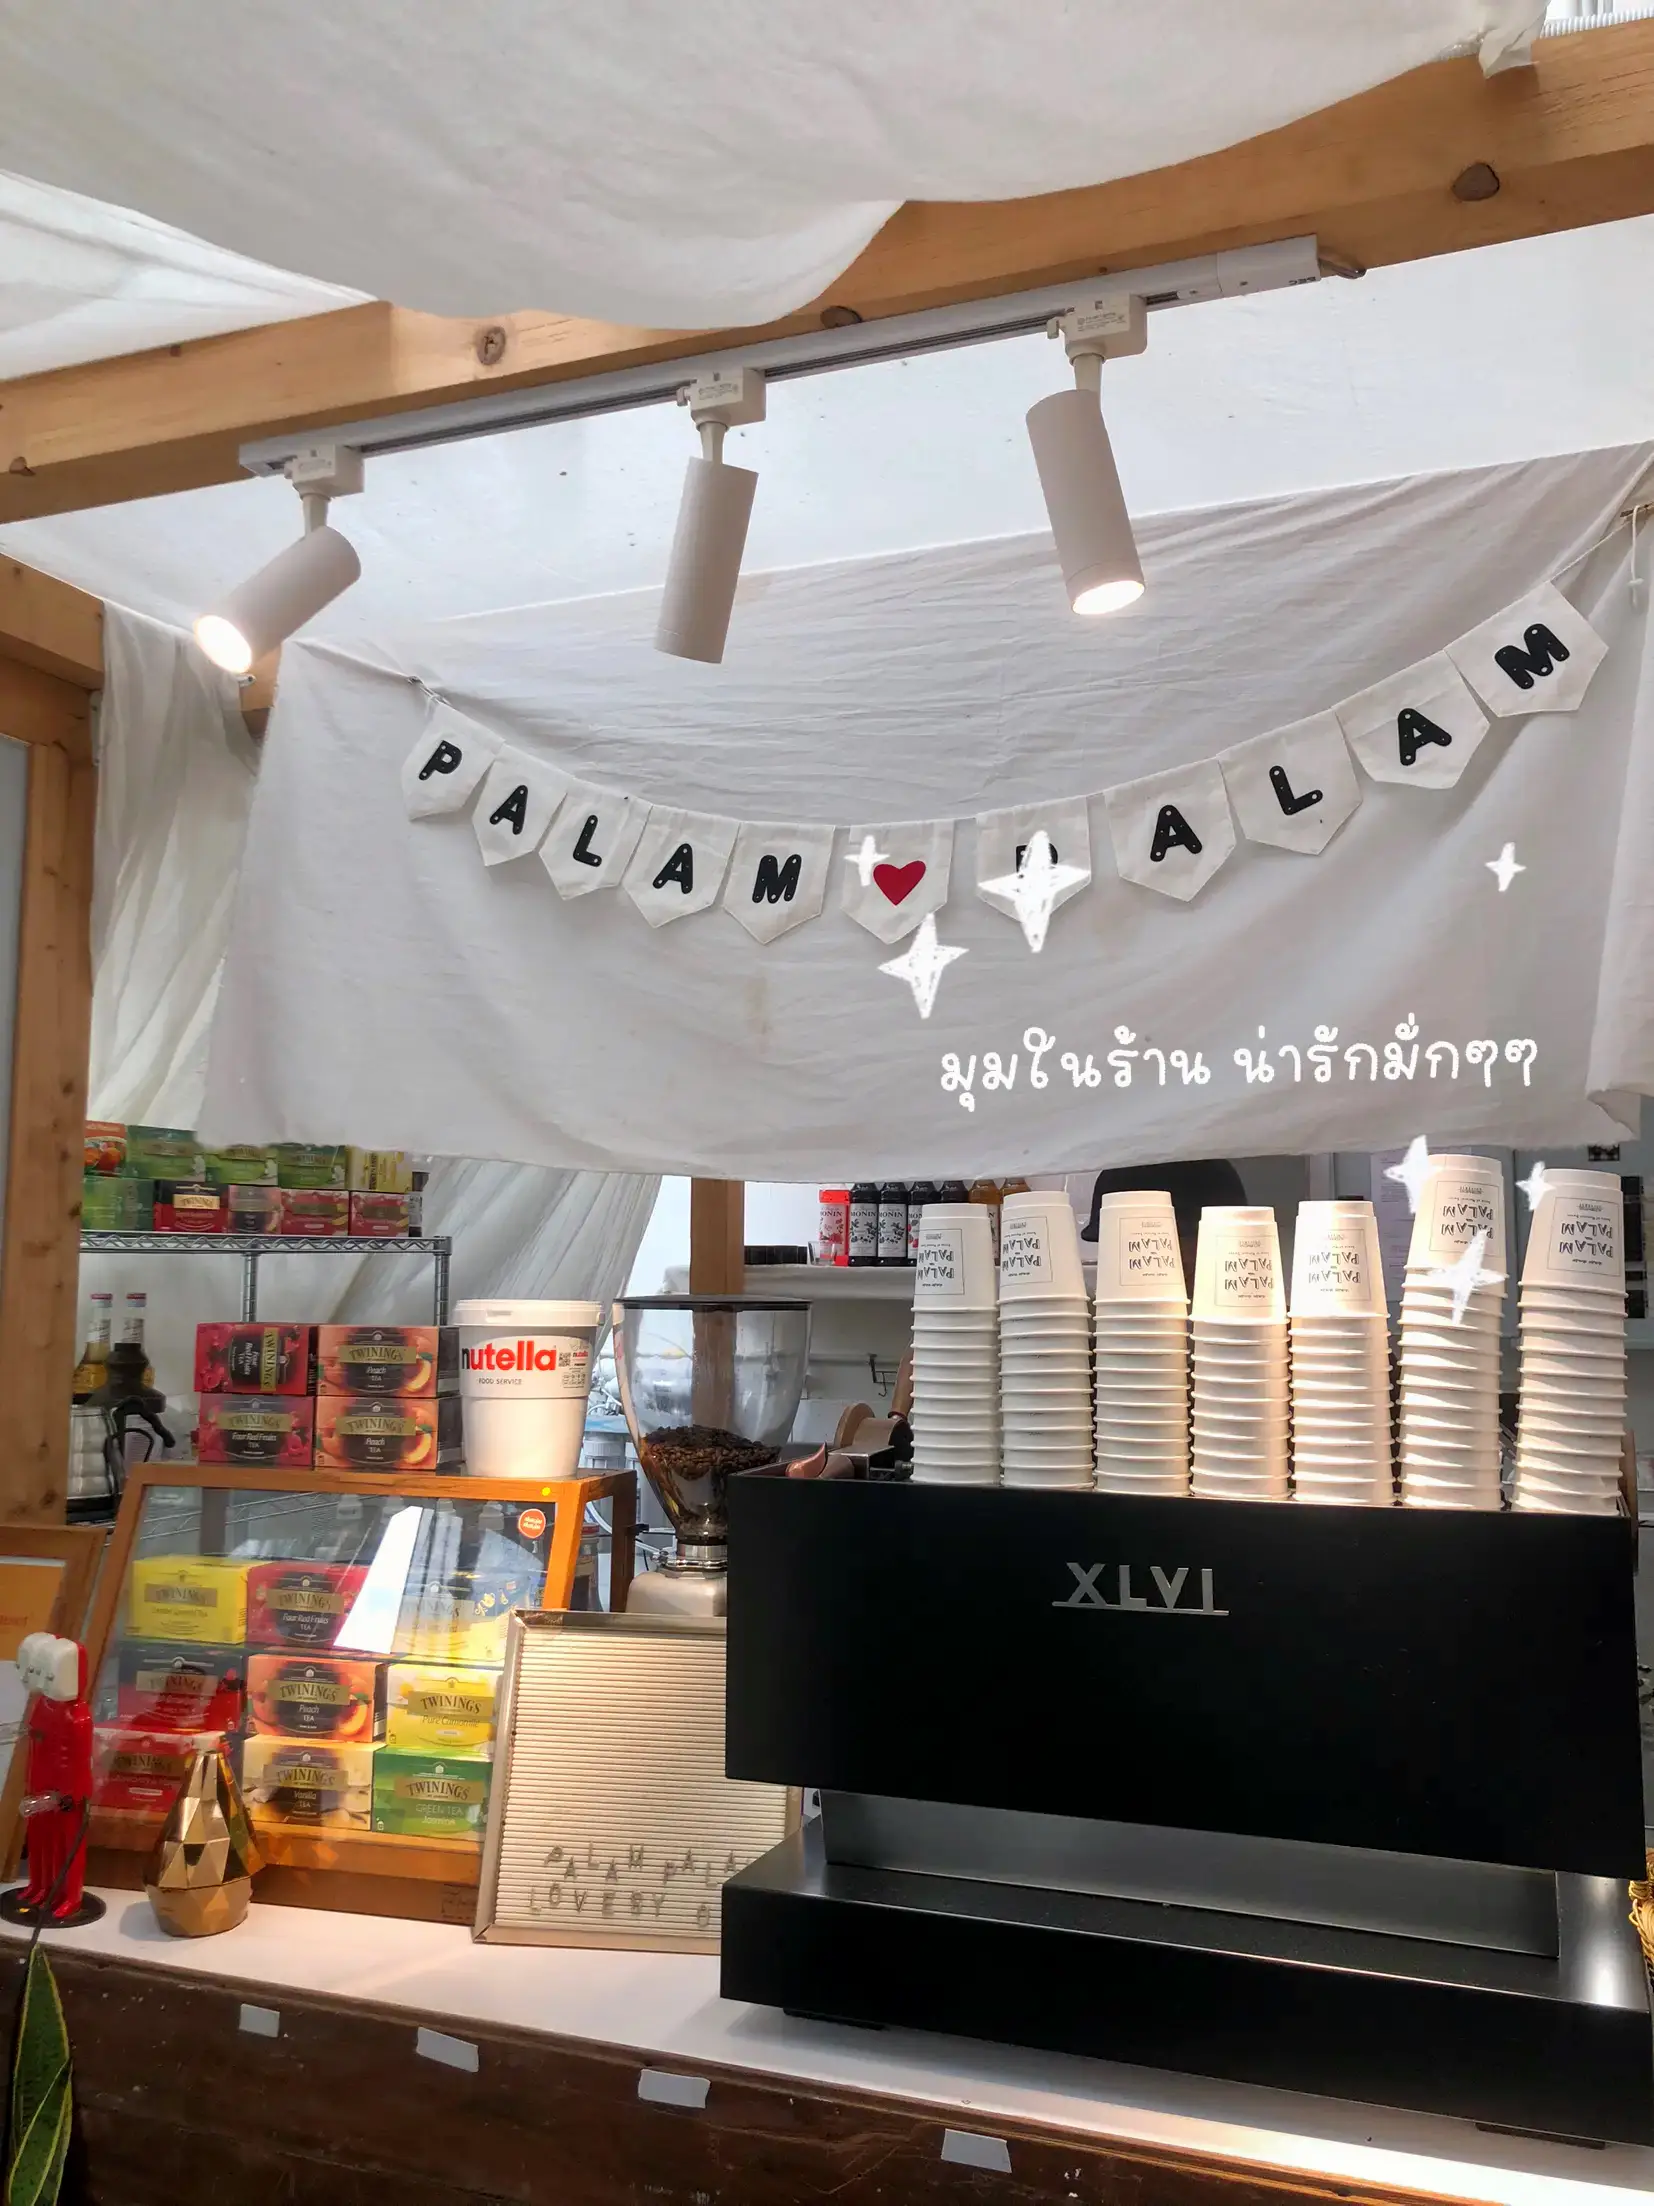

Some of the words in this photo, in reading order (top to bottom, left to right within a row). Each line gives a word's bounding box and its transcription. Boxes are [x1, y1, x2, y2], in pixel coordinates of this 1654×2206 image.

[349, 1346, 404, 1361] TWININGS
[461, 1340, 557, 1371] nutella
[366, 1366, 387, 1375] Peach
[496, 1378, 523, 1386] SERVICE
[346, 1418, 405, 1433] TWININGS
[365, 1437, 386, 1446] Peach
[1066, 1562, 1214, 1612] XLVI
[279, 1592, 332, 1611] TWININGS
[300, 1623, 312, 1631] TEA
[280, 1684, 337, 1703] TWININGS
[298, 1703, 320, 1714] Peach
[420, 1695, 482, 1715] TWININGS
[303, 1714, 315, 1722] TEA
[422, 1714, 441, 1725] Pure
[277, 1768, 336, 1786] TWININGS
[294, 1790, 317, 1800] Vanilla
[406, 1780, 470, 1801] TWININGS
[299, 1800, 311, 1808] TEA
[447, 1804, 464, 1815] TEA
[663, 1848, 750, 1888] PALA
